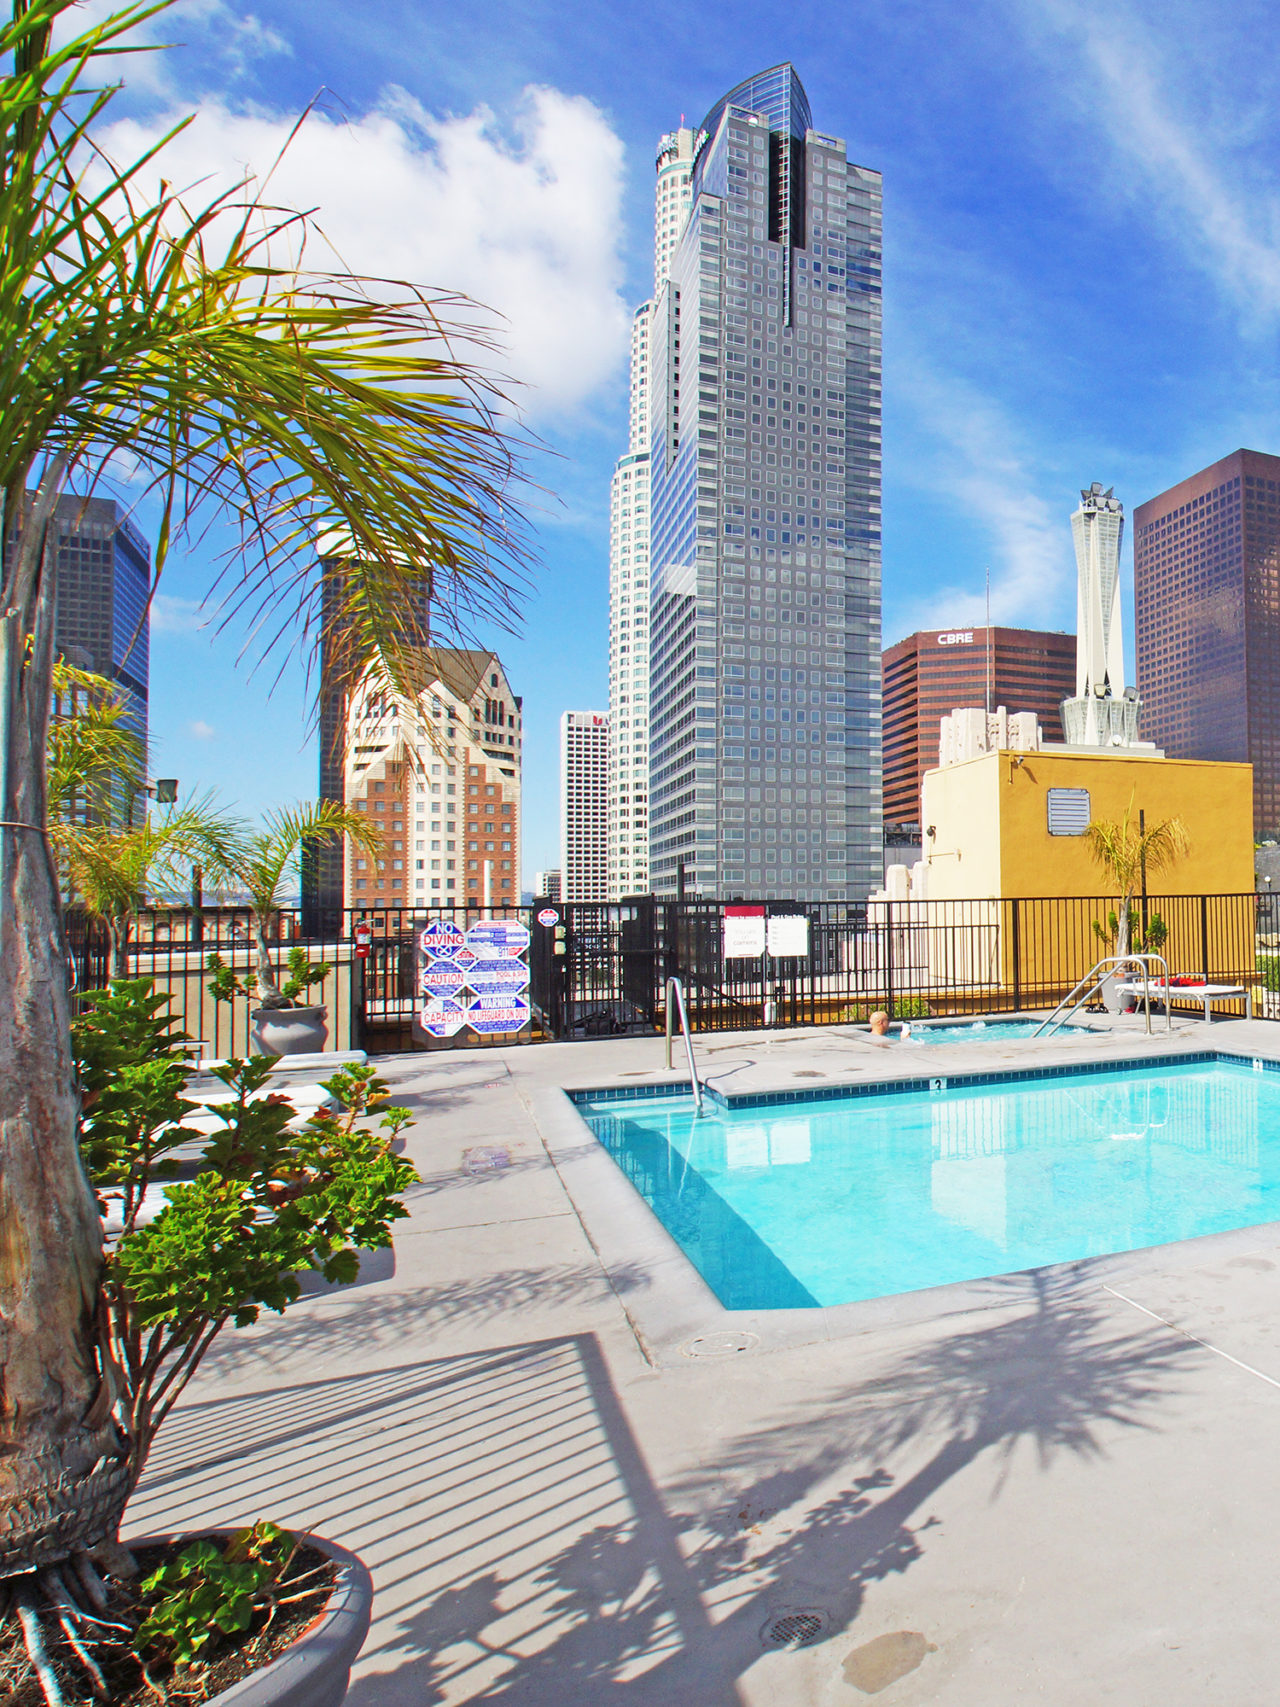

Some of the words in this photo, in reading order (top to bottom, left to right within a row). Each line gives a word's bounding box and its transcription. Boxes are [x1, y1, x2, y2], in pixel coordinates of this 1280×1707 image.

[938, 632, 973, 645] CBRE
[436, 923, 453, 933] NO
[423, 933, 465, 945] DIVING
[423, 973, 464, 985] CAUTION
[481, 997, 517, 1009] WARNING
[424, 1011, 464, 1024] CAPACITY
[468, 1010, 476, 1021] NO
[477, 1009, 505, 1021] LIFEGUARD
[506, 1009, 514, 1019] ON
[515, 1008, 529, 1019] DUTY
